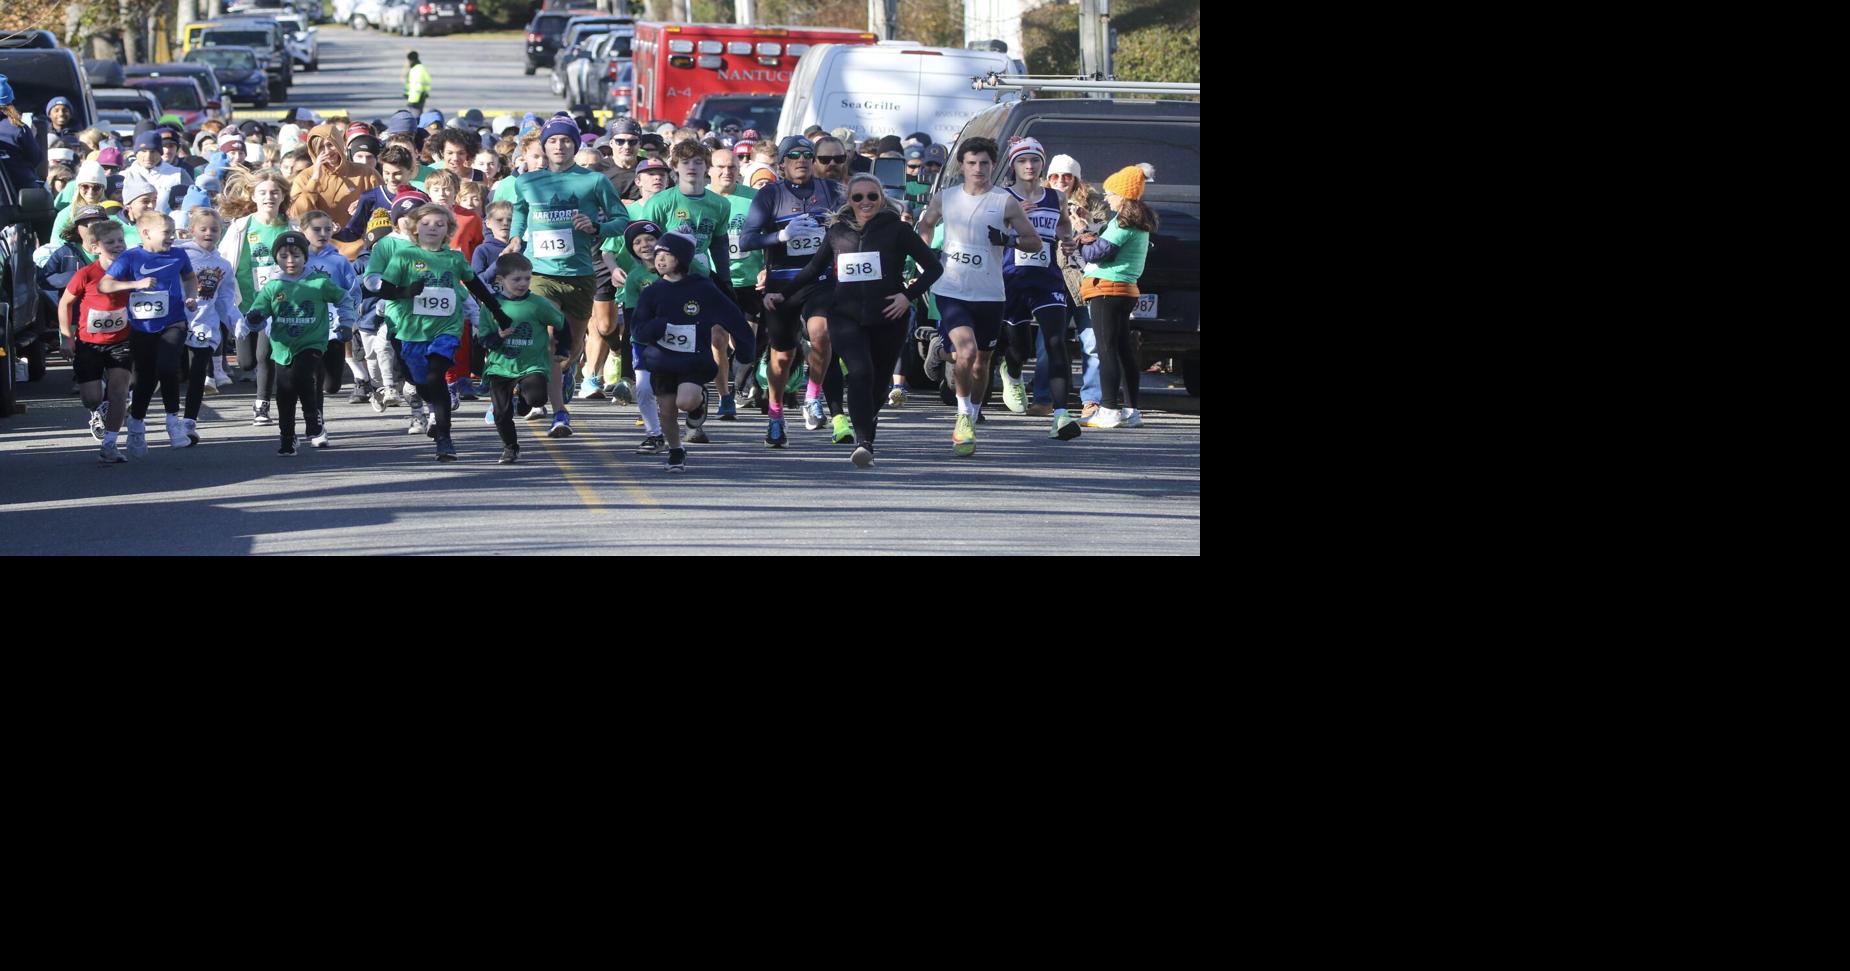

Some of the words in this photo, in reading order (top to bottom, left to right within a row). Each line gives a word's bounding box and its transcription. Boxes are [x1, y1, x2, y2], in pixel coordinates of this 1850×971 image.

[666, 87, 692, 97] A-4
[841, 99, 861, 109] Sea
[864, 100, 902, 111] Grille
[540, 238, 566, 250] 413
[792, 236, 821, 250] 323
[951, 251, 982, 266] 450
[845, 262, 873, 275] 518
[134, 300, 164, 313] 603
[422, 297, 449, 309] 198
[92, 317, 124, 329] 606
